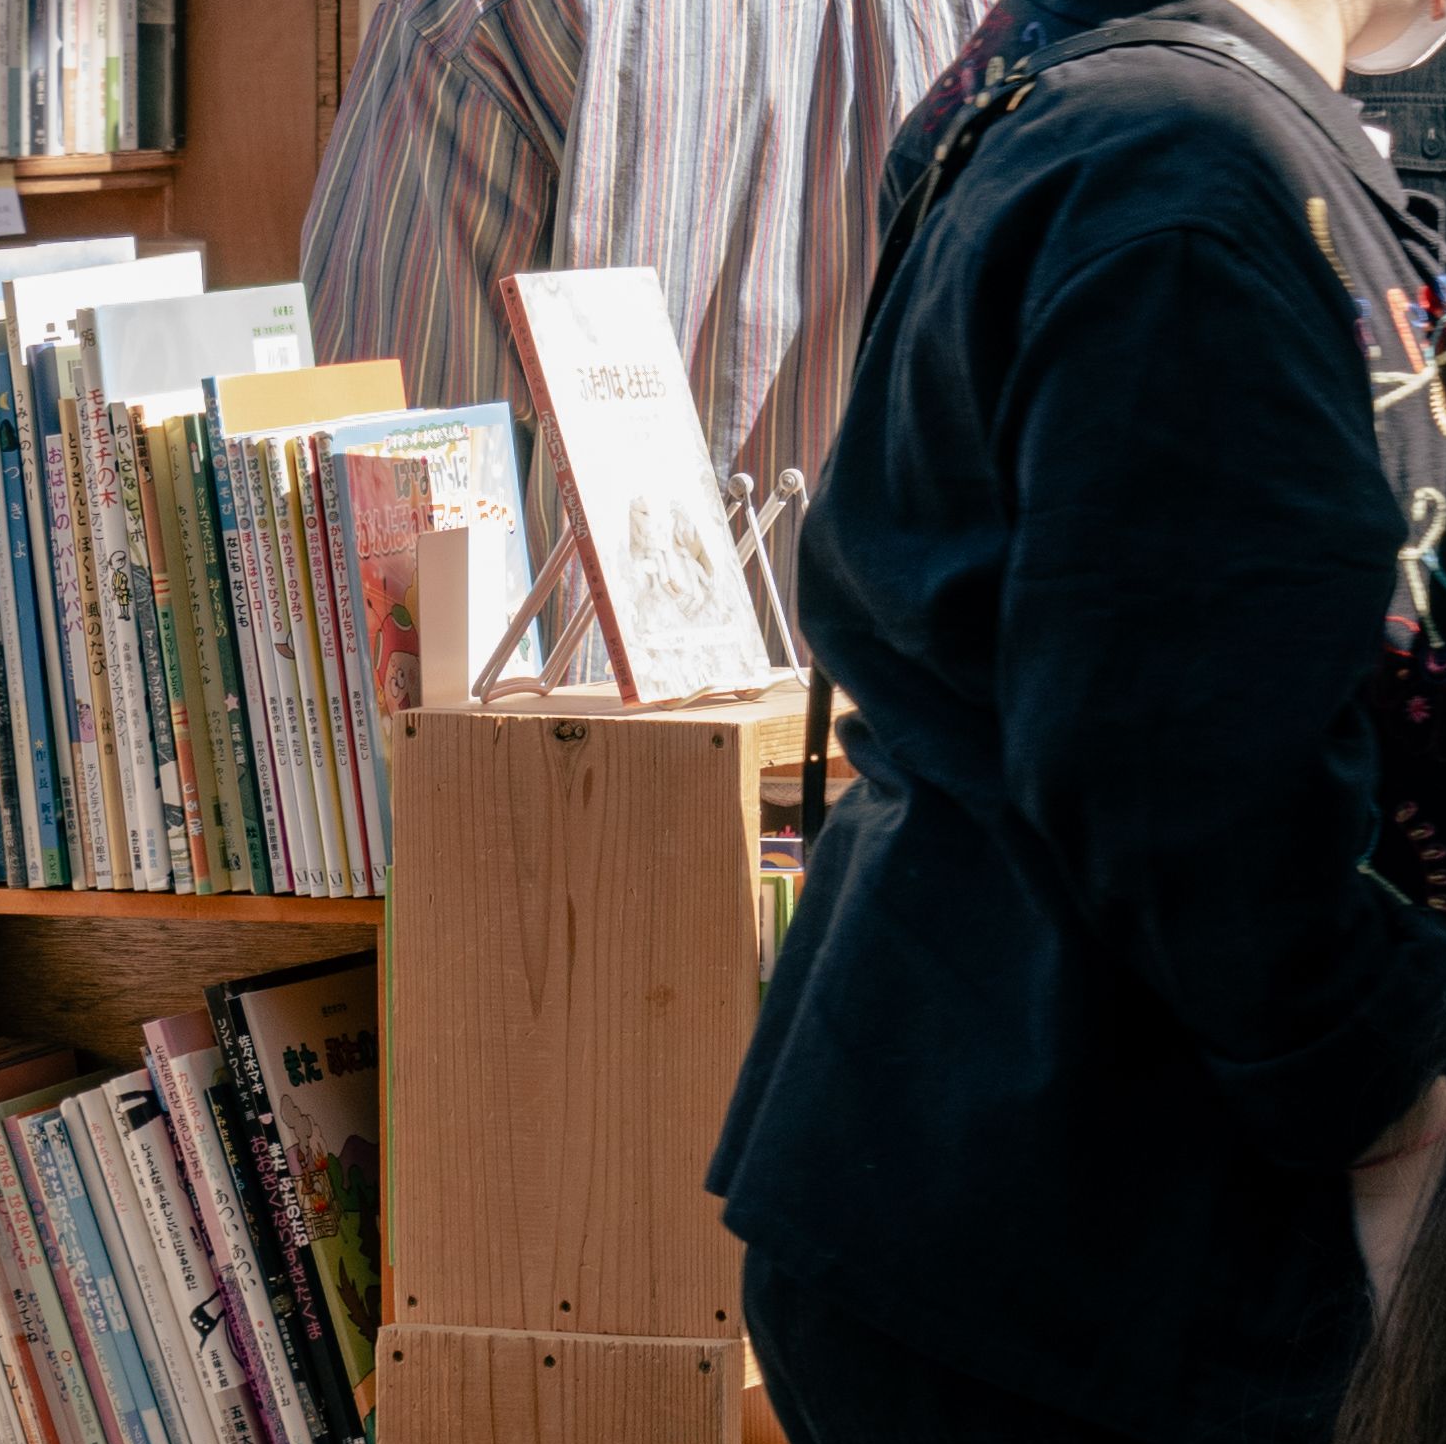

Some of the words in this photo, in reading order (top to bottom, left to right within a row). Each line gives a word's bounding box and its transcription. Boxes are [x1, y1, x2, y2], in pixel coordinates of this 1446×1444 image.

[16, 390, 36, 501] うみべのハリー
[88, 387, 119, 509] モチモチの木
[116, 423, 137, 491] ちいさな
[67, 432, 88, 526] とうさんと
[3, 466, 28, 559] つきよ
[48, 446, 84, 633] おばけのバーバパパ
[126, 495, 146, 544] ヒッポ
[77, 535, 95, 592] ぼくと
[226, 536, 242, 574] なにも
[240, 530, 258, 577] ぼくらは
[258, 532, 277, 586] そっくりで
[280, 532, 304, 624] がりぞーのひみつ
[309, 532, 328, 602] おかあさんと
[208, 578, 228, 638] おくりもの
[232, 577, 249, 628] なくても
[267, 588, 284, 633] びっくり
[85, 601, 106, 678] 風のたび
[316, 604, 335, 659] いっしょに
[269, 696, 282, 734] あきやま
[285, 696, 298, 735] あきやま
[292, 738, 304, 767] ただし
[306, 697, 319, 736] あきやま
[331, 696, 344, 734] あきやま
[352, 690, 366, 728] あきやま
[275, 738, 287, 767] ただし
[312, 739, 325, 768] ただし
[336, 737, 348, 767] ただし
[358, 733, 370, 761] ただし
[215, 1016, 246, 1088] リンド・ワード
[236, 1033, 266, 1095] 佐々木マキ
[266, 1140, 288, 1172] また
[278, 1176, 309, 1248] ぶたのたね
[213, 1187, 241, 1238] あつい
[230, 1242, 257, 1294] あつい
[250, 1133, 324, 1341] おおきくなりすぎたくま
